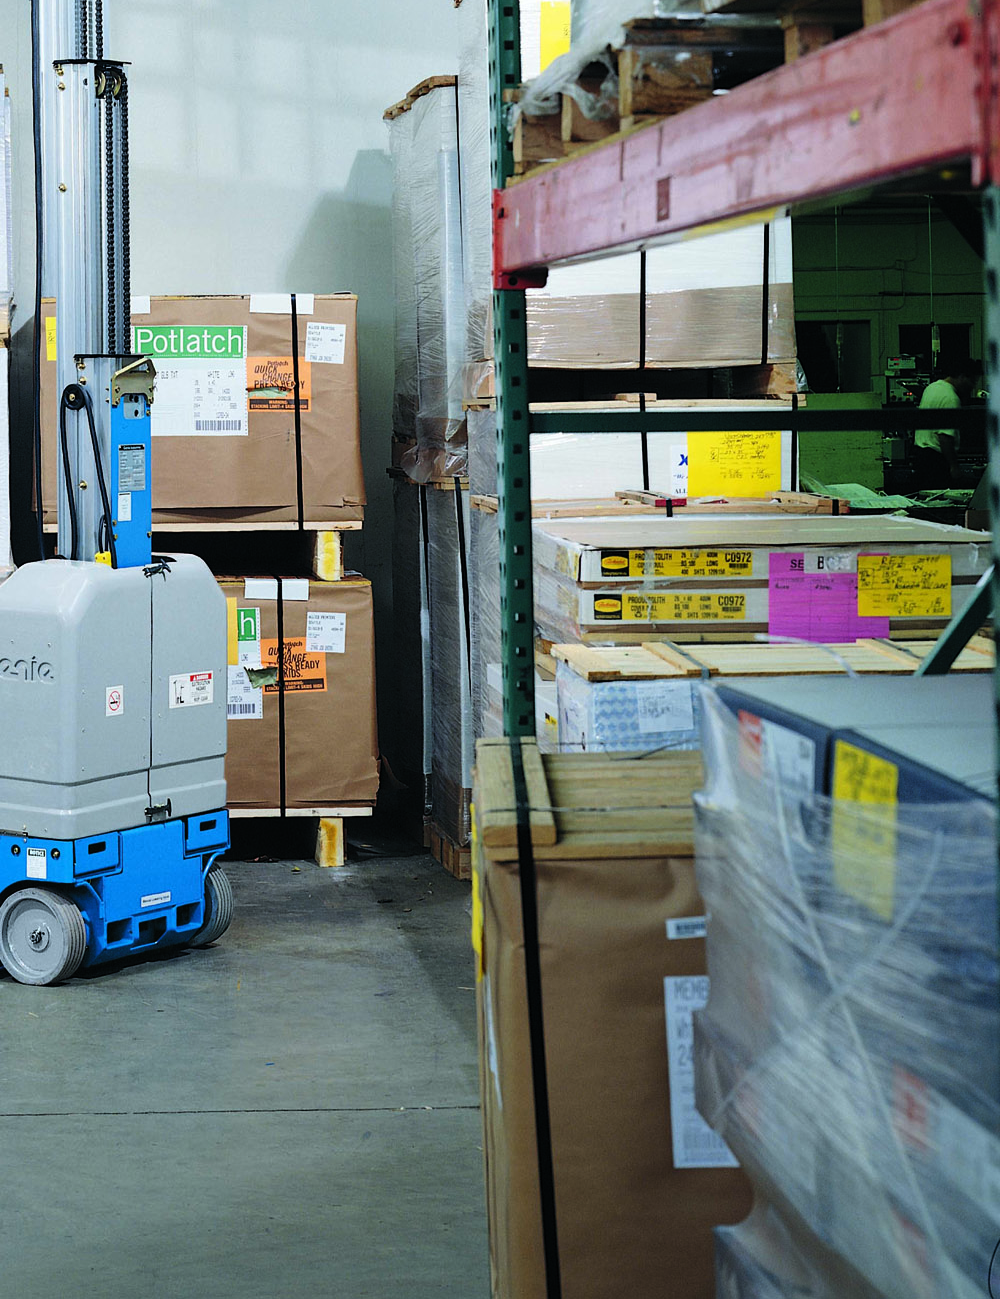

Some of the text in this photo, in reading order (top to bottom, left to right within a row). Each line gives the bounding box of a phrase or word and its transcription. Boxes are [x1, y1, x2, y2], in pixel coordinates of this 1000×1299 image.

[137, 328, 242, 353] Potlatch
[254, 365, 278, 374] QUICK
[262, 372, 293, 381] CHANGE
[724, 552, 751, 563] C0972
[790, 559, 804, 569] SE
[718, 596, 745, 606] C0972
[674, 980, 710, 1001] MEMB
